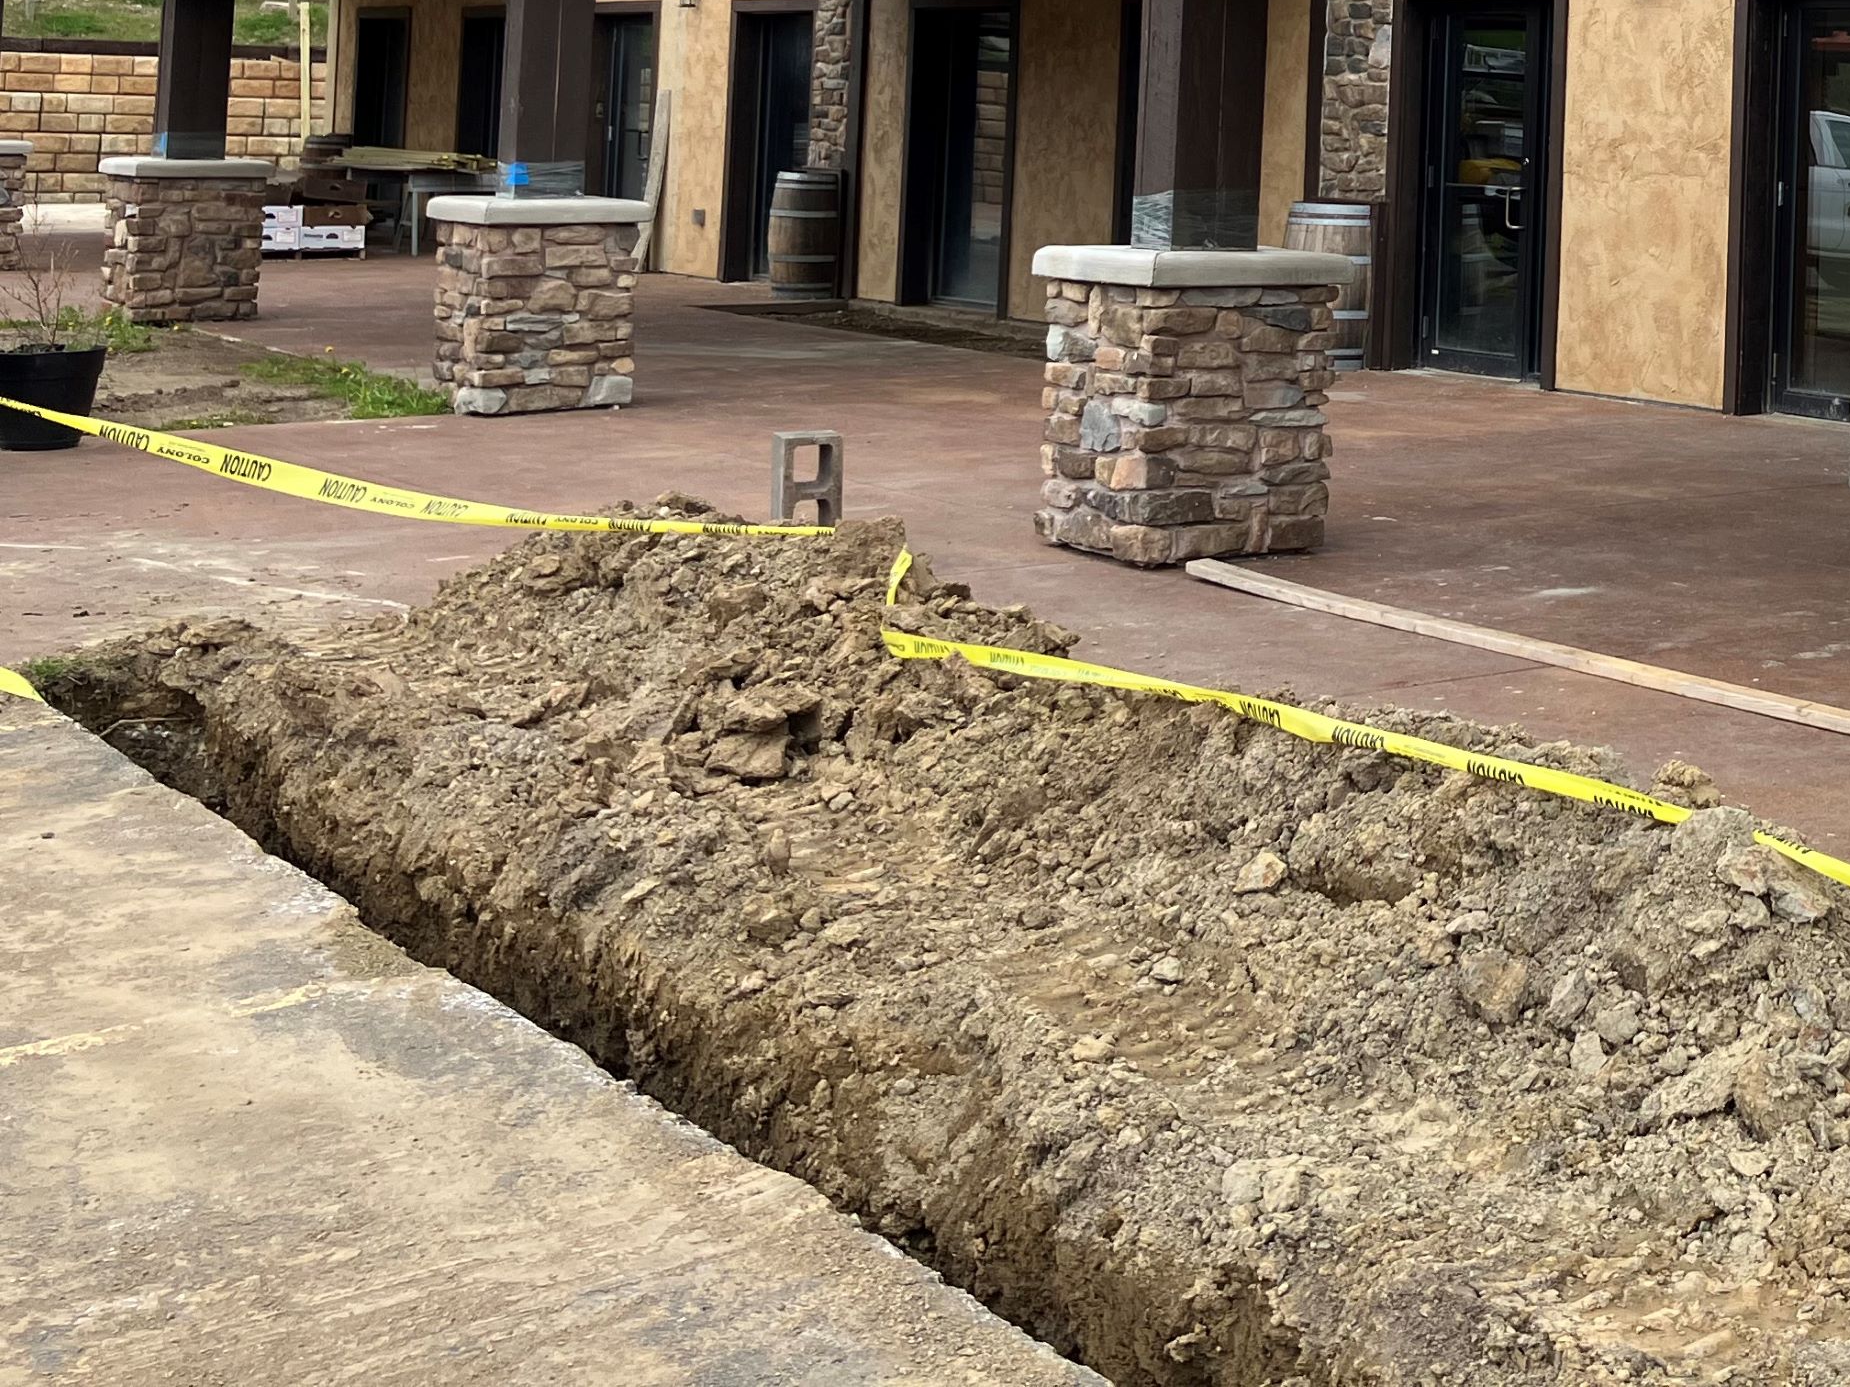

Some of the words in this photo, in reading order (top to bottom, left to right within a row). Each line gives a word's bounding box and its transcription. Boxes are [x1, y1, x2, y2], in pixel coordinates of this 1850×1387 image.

[98, 424, 150, 452] CAUTION
[156, 446, 210, 464] COLONY
[219, 453, 272, 482] CAUTION
[318, 477, 368, 503] CAUTION
[420, 499, 469, 518] CAUTION
